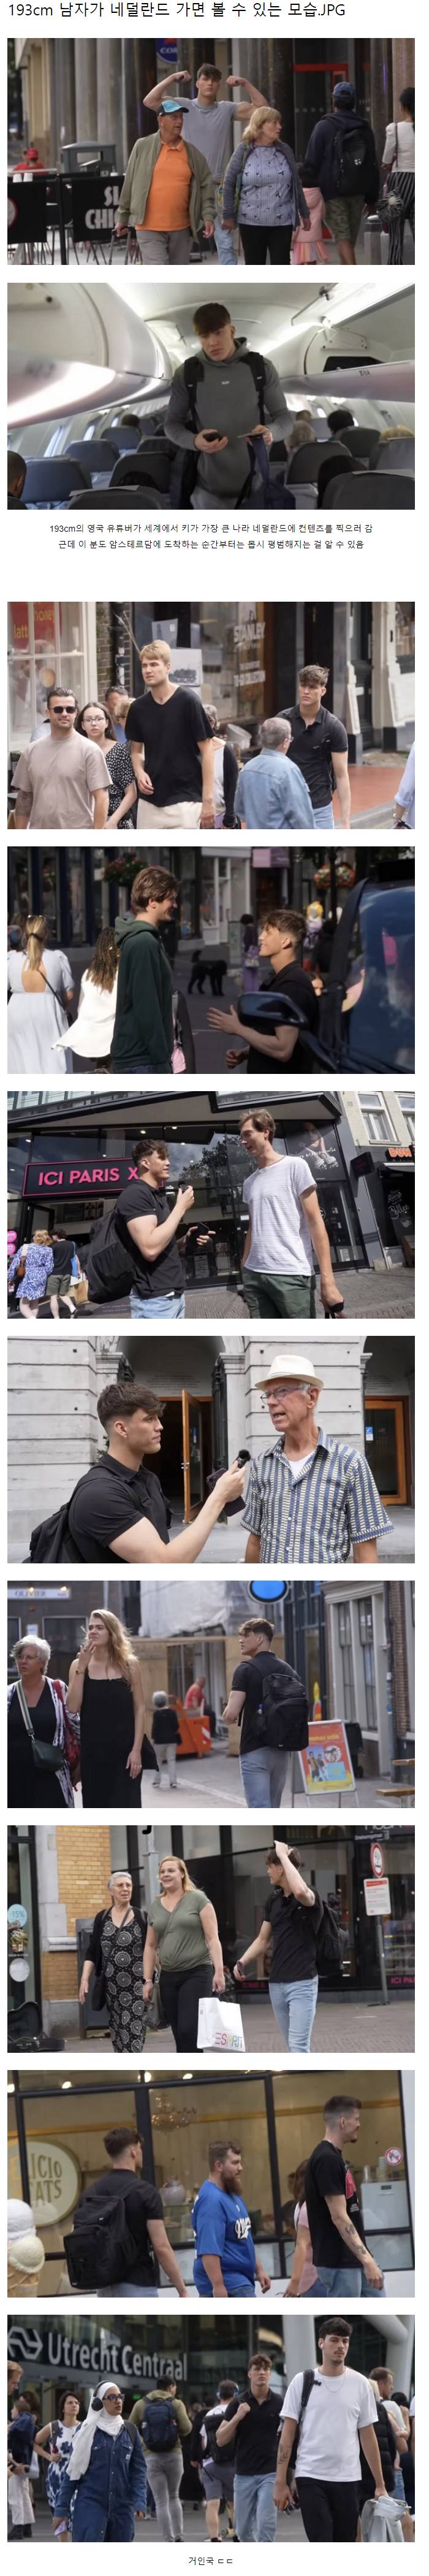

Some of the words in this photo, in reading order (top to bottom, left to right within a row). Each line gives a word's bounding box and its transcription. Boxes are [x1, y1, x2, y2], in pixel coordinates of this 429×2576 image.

[233, 622, 266, 643] STANLEY
[39, 1171, 63, 1186] ICI
[69, 1167, 120, 1184] PARIS
[215, 2032, 243, 2048] ESPRIT
[48, 2332, 120, 2373] Utrecht
[122, 2345, 187, 2382] Centraal
